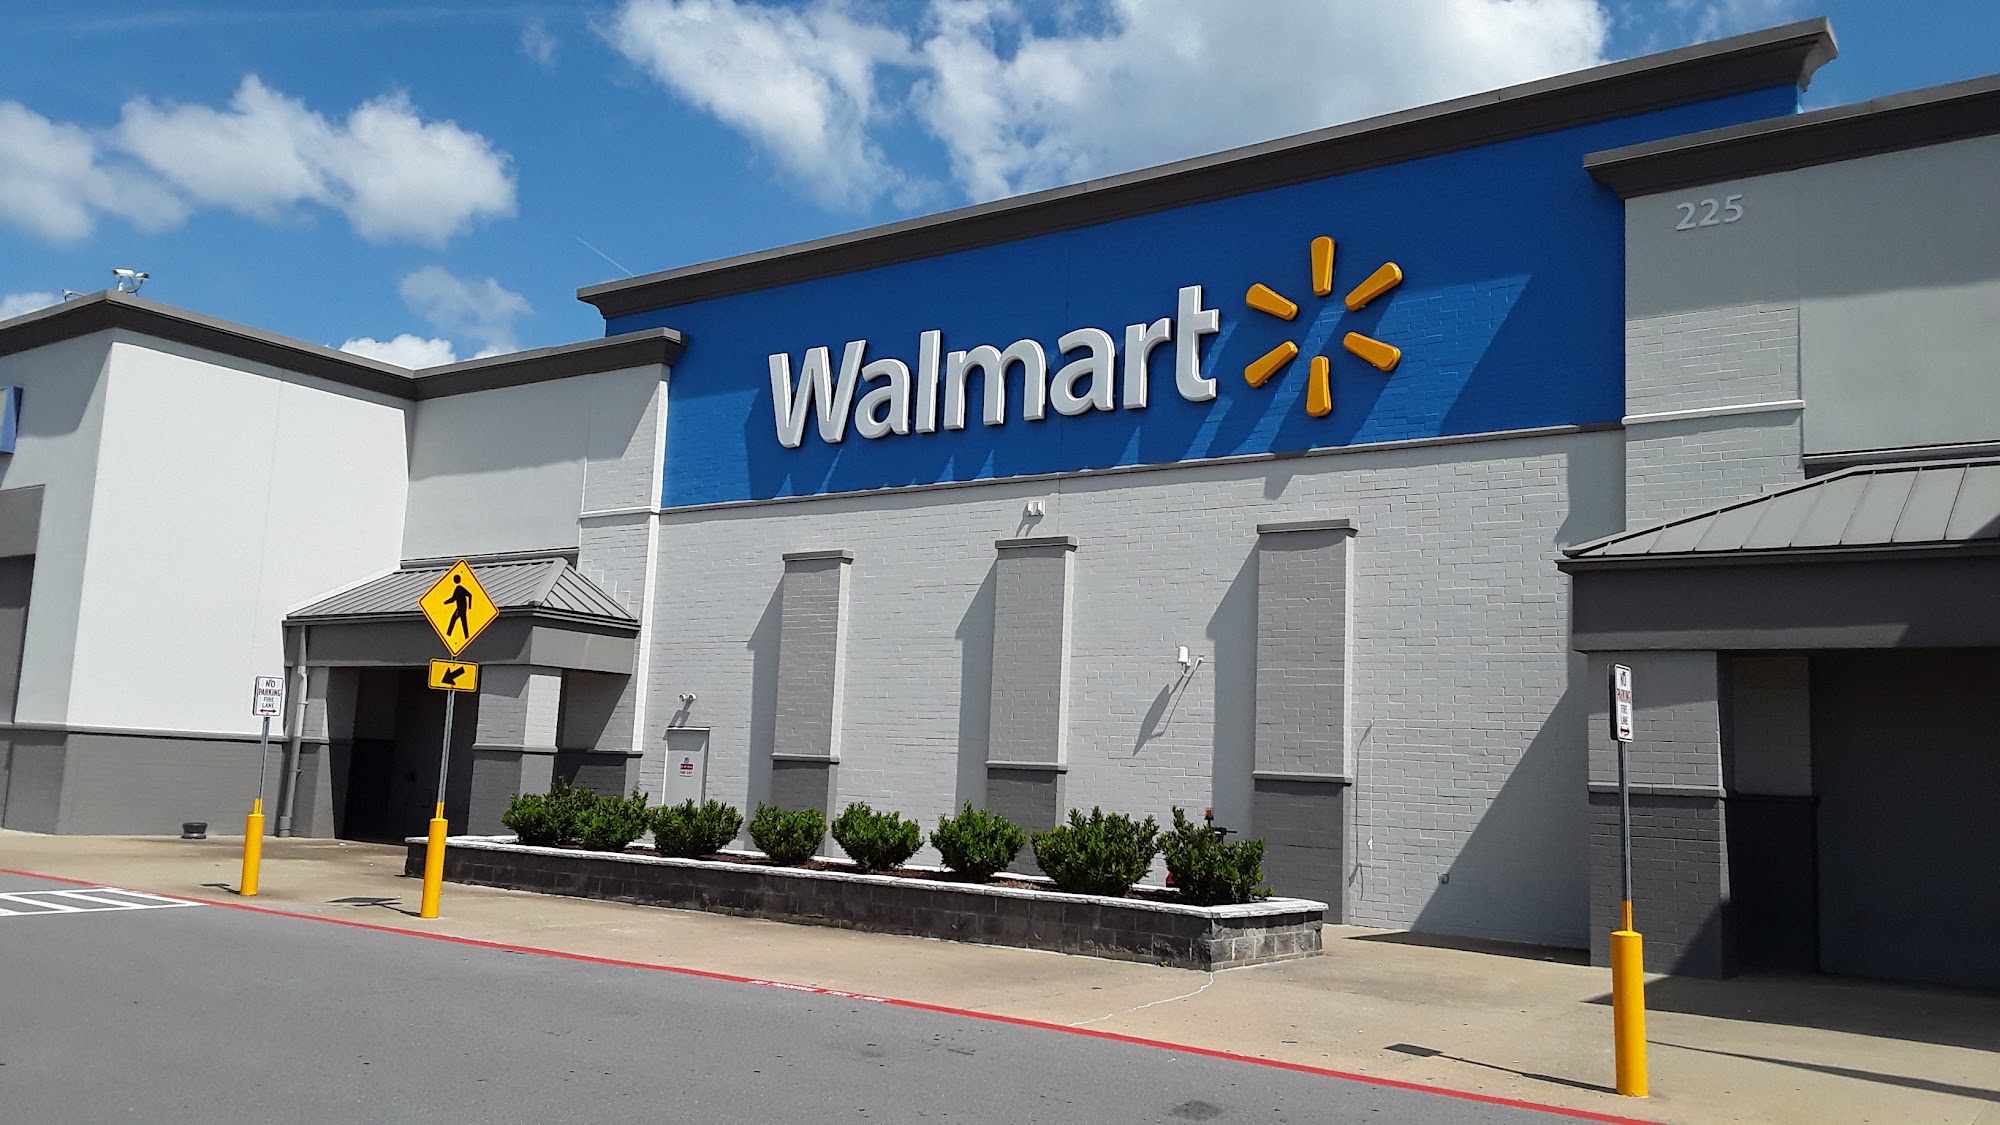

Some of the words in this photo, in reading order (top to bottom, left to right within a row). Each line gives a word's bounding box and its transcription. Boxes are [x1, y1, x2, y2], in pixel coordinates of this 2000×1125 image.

[1676, 194, 1743, 231] 225
[768, 284, 1220, 449] Walmart
[258, 688, 281, 697] PARKING
[265, 680, 276, 688] NO
